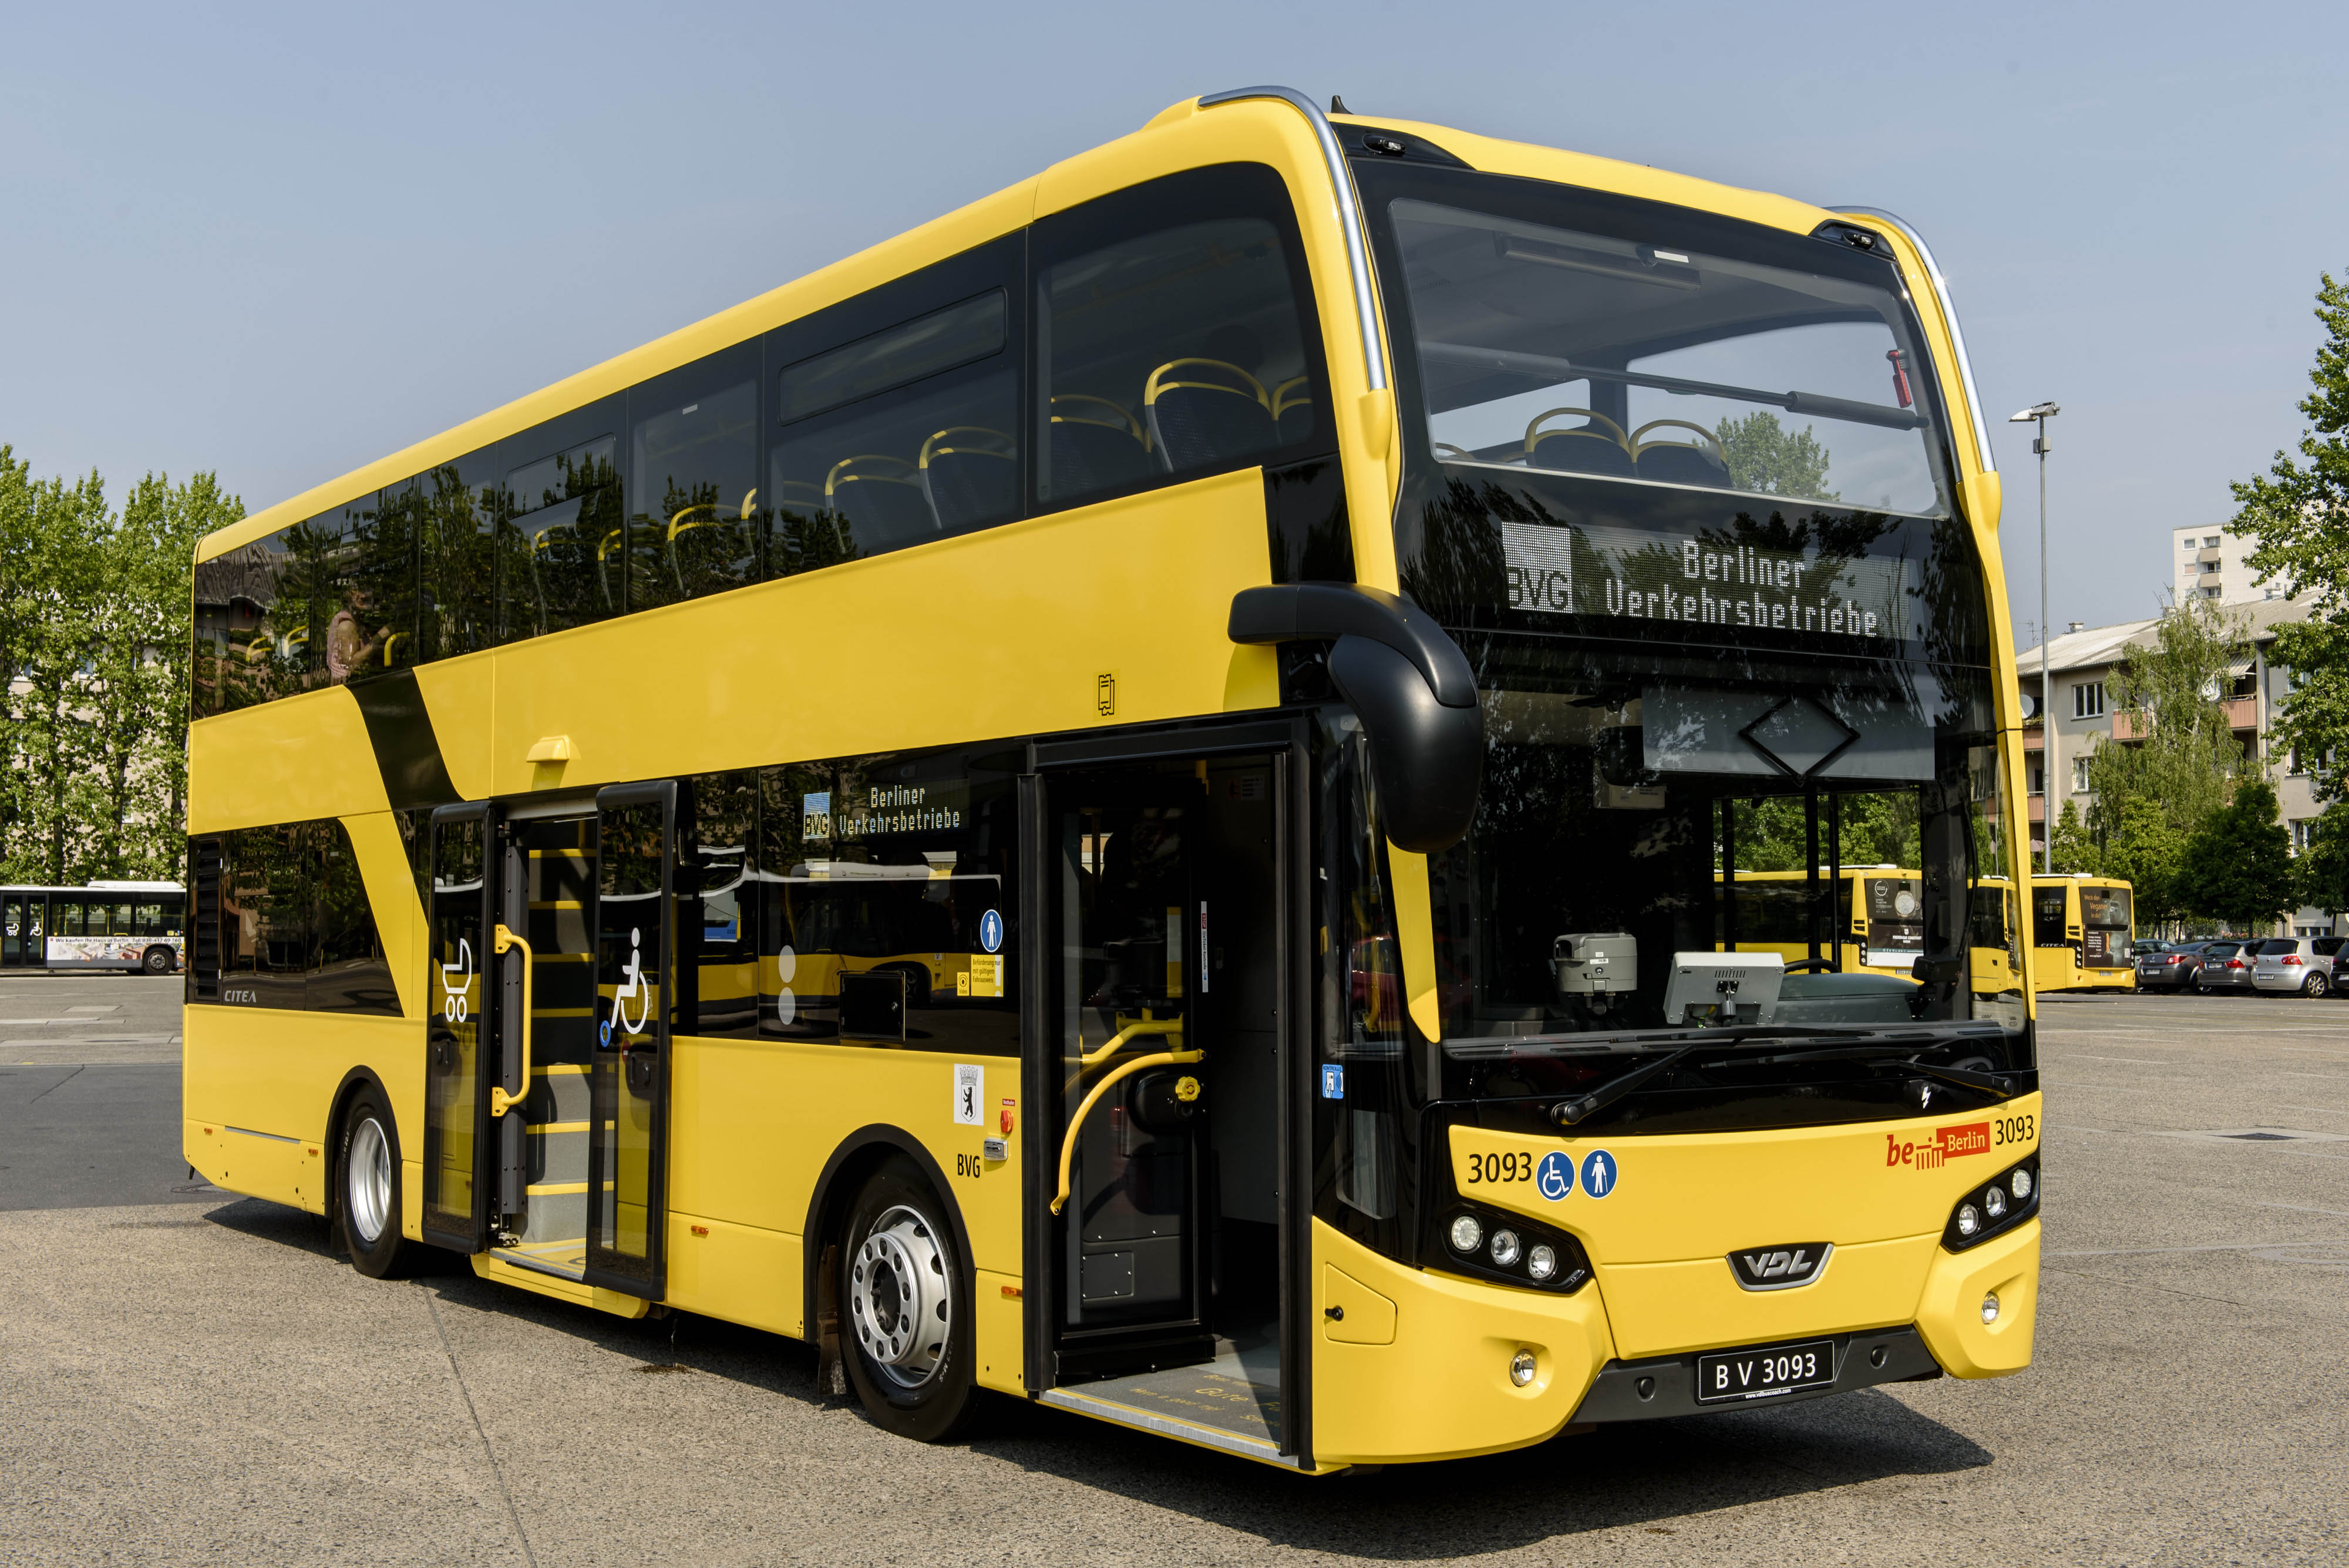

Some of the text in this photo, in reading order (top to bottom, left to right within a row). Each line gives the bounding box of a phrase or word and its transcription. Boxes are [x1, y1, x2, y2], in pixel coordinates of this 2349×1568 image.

[1683, 540, 1805, 588] Berliner
[1507, 566, 1571, 610] BVG
[1606, 578, 1877, 638] Verkehrsbetriebe
[870, 785, 926, 808] Berliner
[839, 807, 960, 835] Verkehrsbetriebe
[2089, 903, 2108, 911] Veganer
[972, 958, 994, 967] Beförderung
[224, 990, 257, 1003] CITEA
[1995, 1115, 2034, 1146] 3093
[1887, 1131, 1985, 1167] be Berlin
[957, 1153, 980, 1178] BVG
[1468, 1152, 1532, 1183] 3093
[1744, 1250, 1812, 1278] VDL
[1716, 1353, 1816, 1389] B V 3093
[1745, 1388, 1791, 1399] www.vdlbuscoach.com
